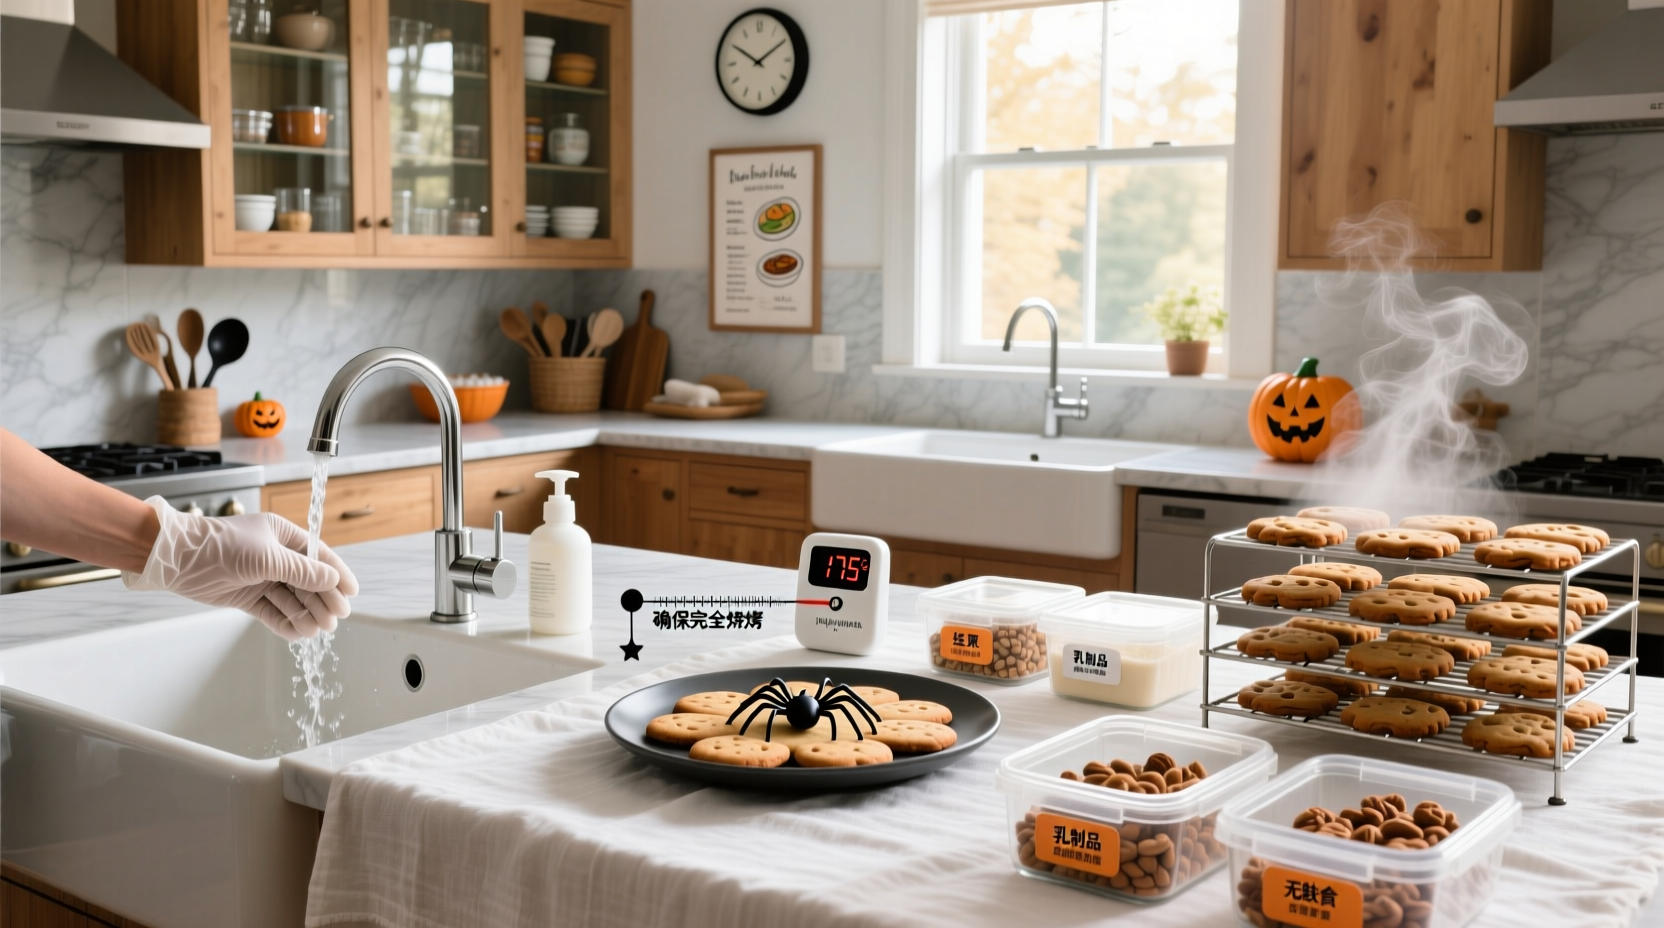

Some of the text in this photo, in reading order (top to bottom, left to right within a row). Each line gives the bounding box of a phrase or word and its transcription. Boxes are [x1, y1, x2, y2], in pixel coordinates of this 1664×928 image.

[1073, 649, 1108, 668] 乳制品
[1052, 825, 1102, 851] 乳制品
